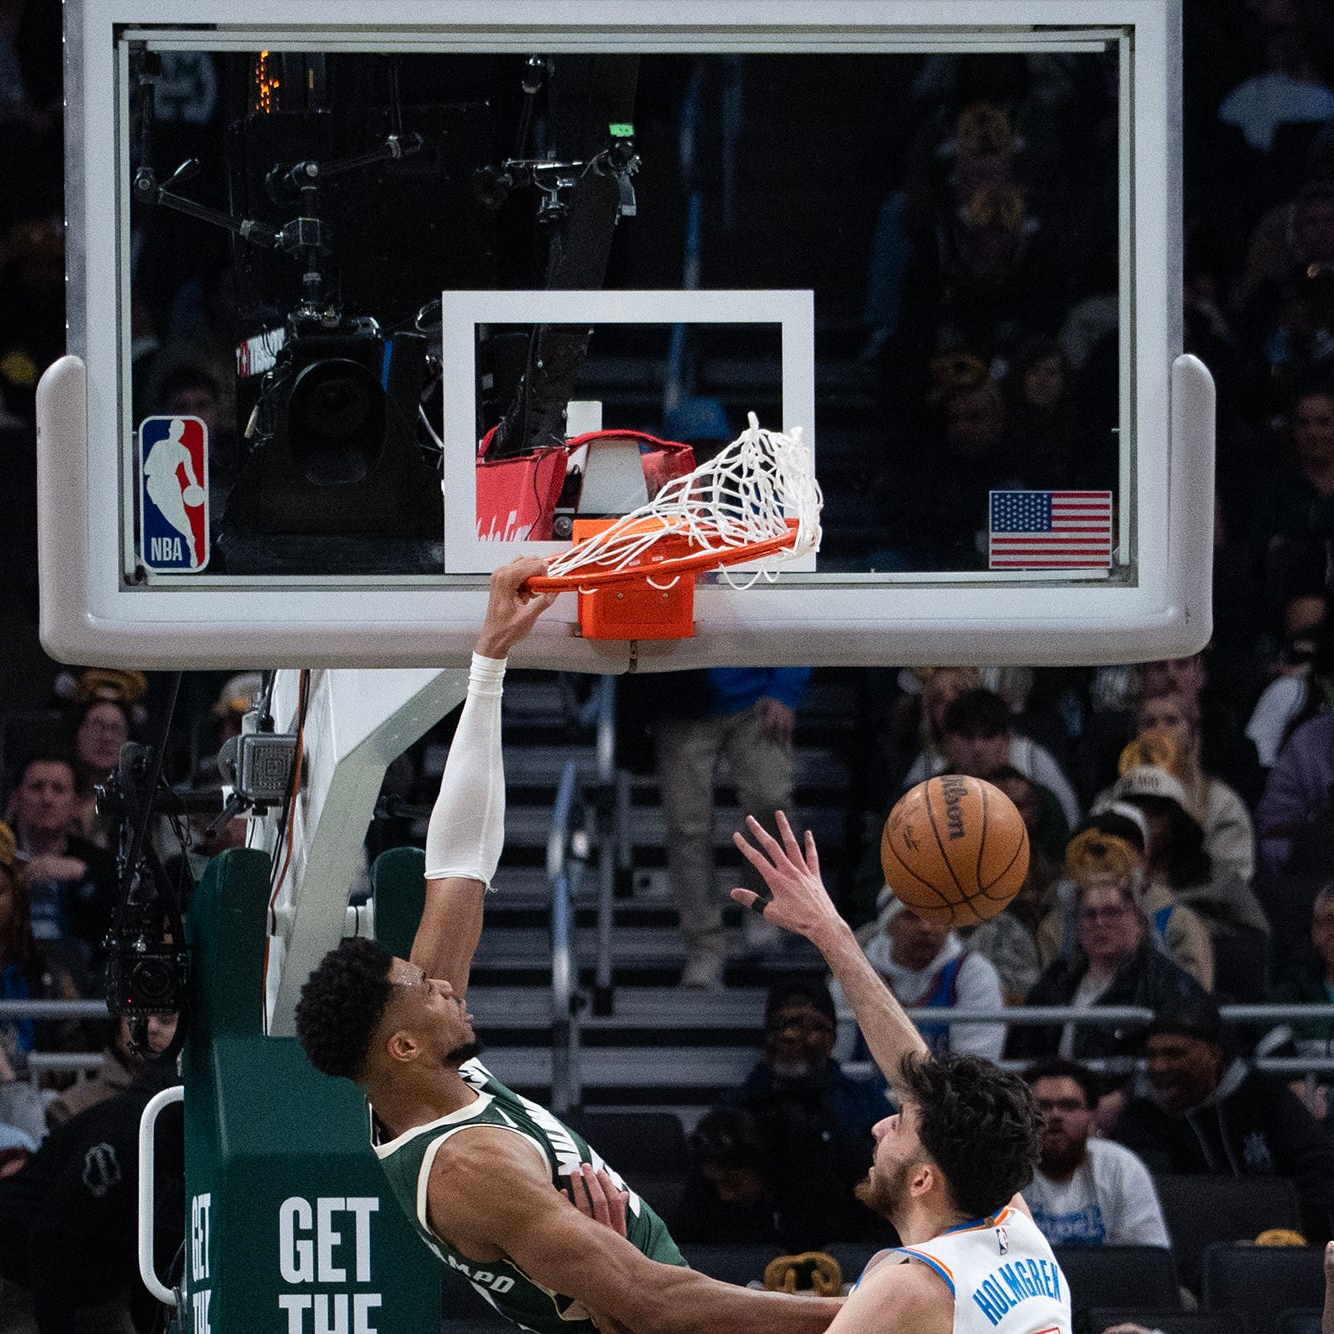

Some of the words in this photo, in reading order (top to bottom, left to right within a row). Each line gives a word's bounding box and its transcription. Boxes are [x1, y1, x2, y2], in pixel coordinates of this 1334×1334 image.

[150, 537, 183, 562] NBA
[190, 1192, 213, 1283] GET
[278, 1196, 381, 1284] GET
